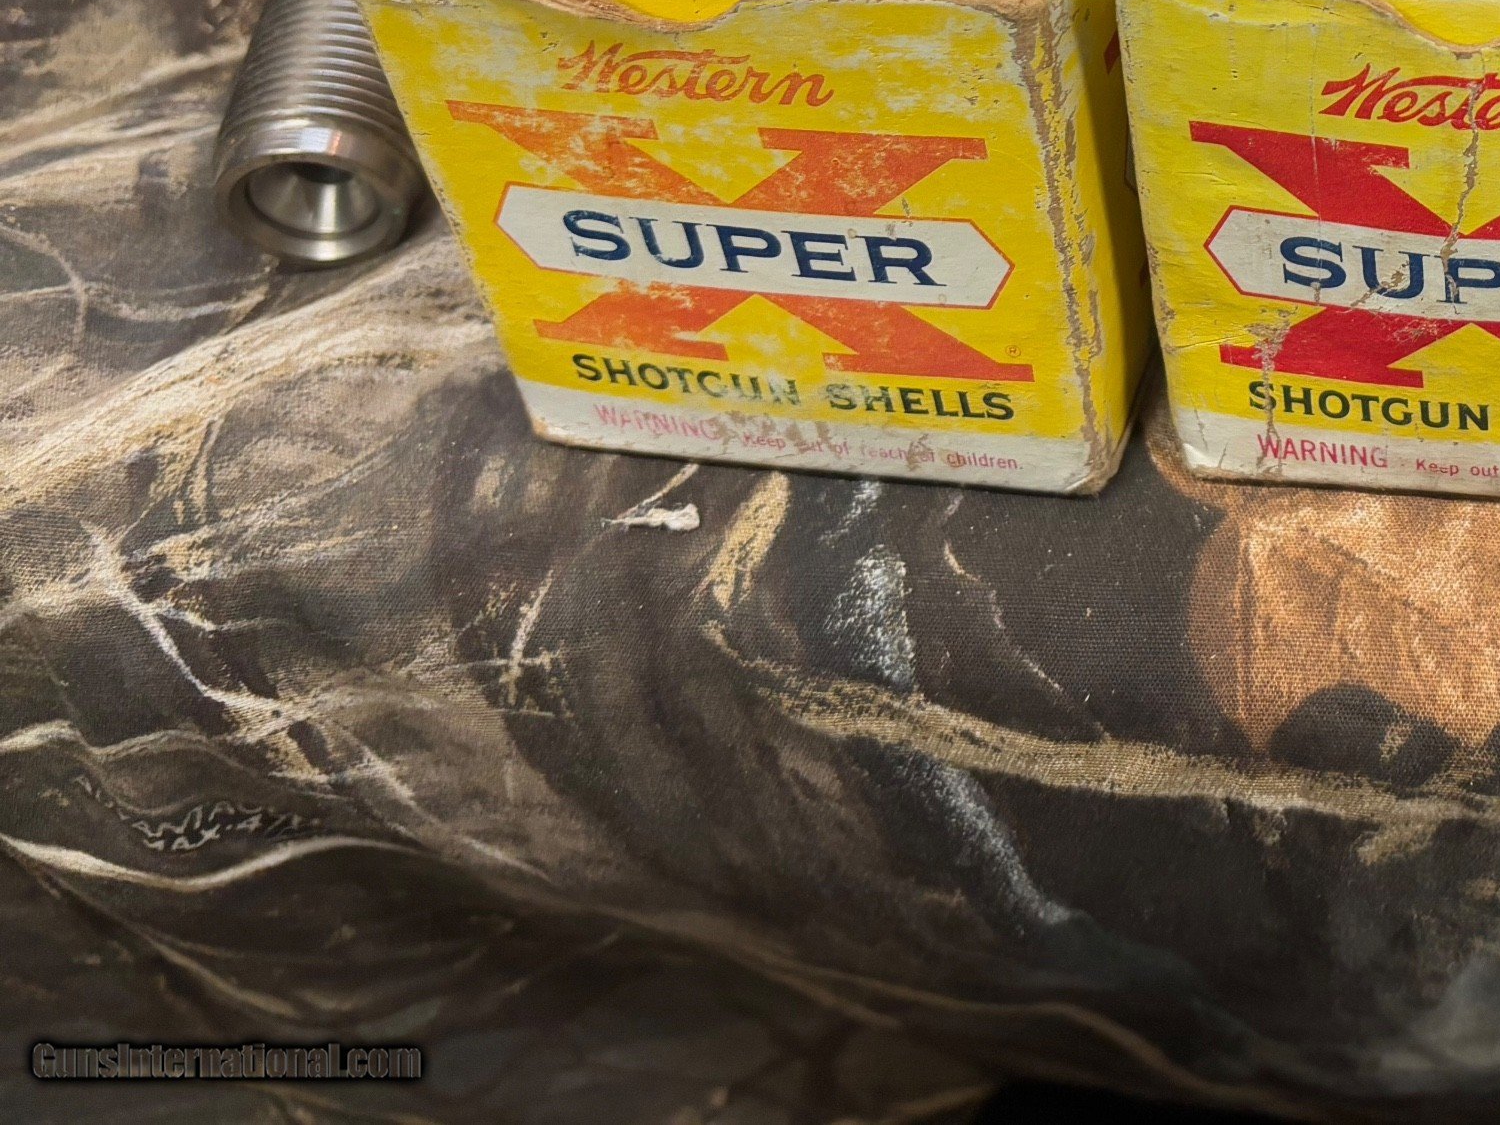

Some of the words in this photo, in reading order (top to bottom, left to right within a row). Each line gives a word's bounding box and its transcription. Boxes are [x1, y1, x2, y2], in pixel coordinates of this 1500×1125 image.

[556, 40, 835, 107] Western
[563, 209, 947, 287] SUPER
[572, 353, 802, 406] SHOTGUN
[825, 383, 1015, 421] SHELLS
[1248, 380, 1489, 431] SHOTGUN
[1256, 433, 1388, 468] WARNING
[1416, 458, 1460, 476] Keep
[1470, 463, 1500, 478] out
